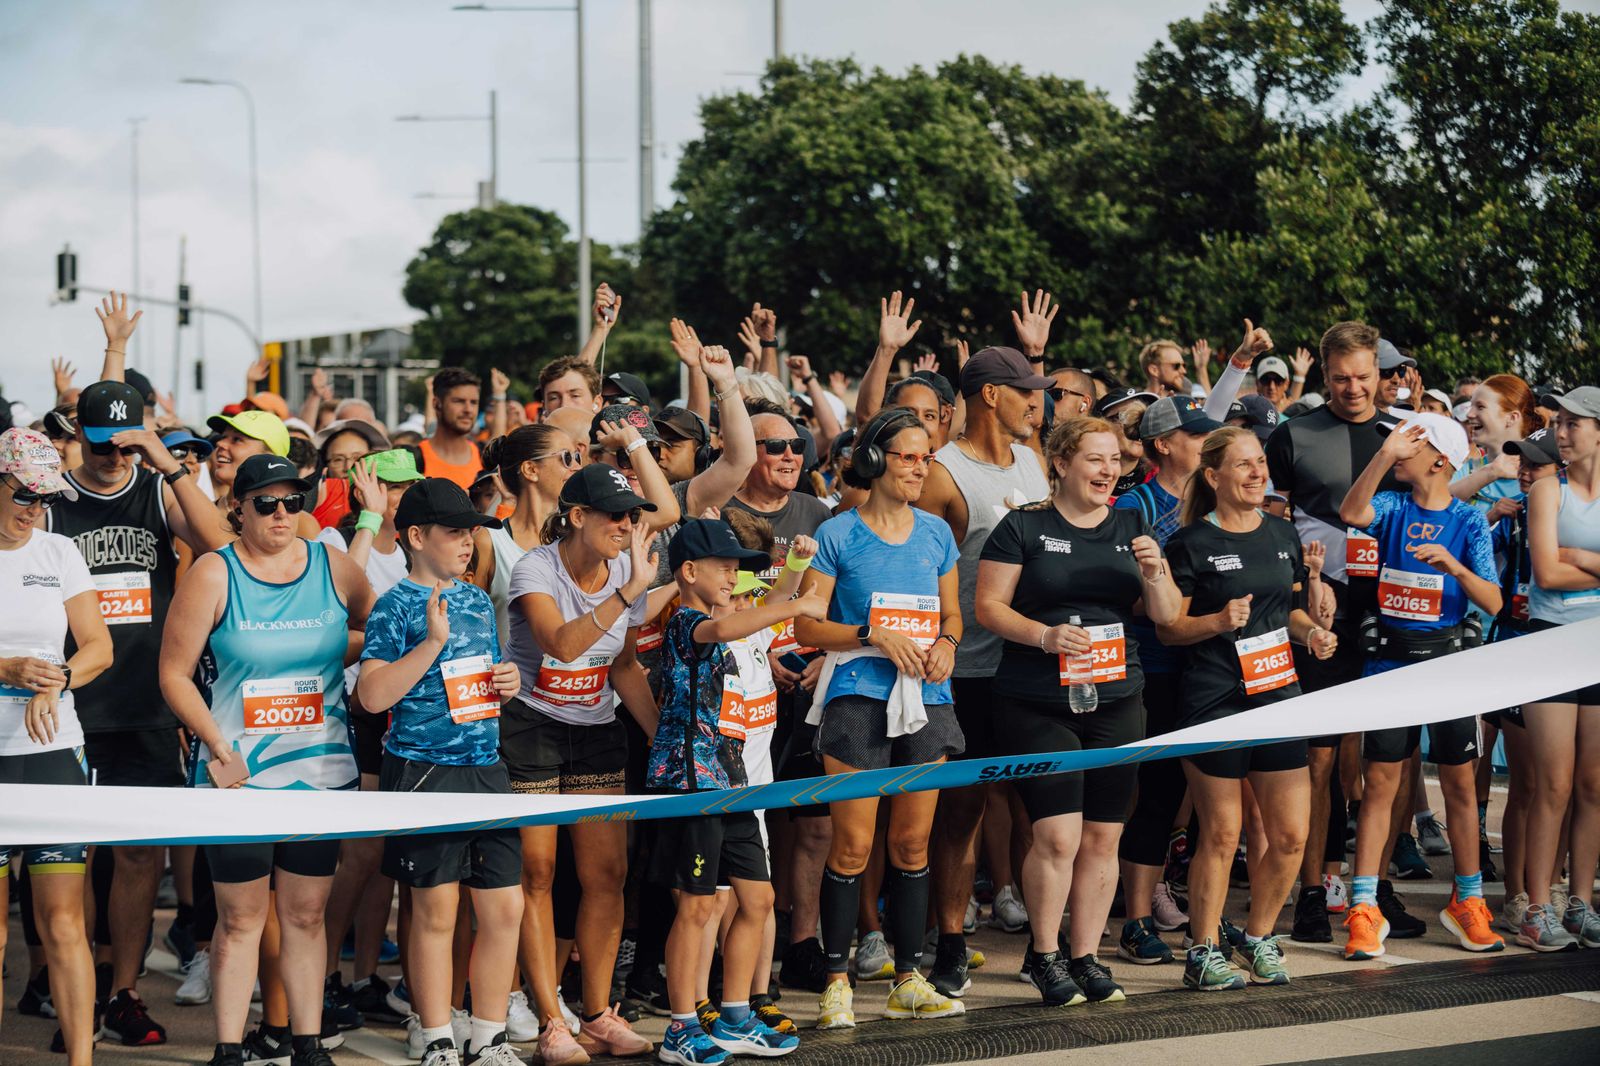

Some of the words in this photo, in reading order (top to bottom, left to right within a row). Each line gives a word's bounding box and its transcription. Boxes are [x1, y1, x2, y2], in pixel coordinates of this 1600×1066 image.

[109, 399, 127, 421] NY
[1406, 522, 1445, 541] CR7
[100, 598, 144, 615] 0244
[1383, 593, 1430, 612] 20165
[239, 618, 323, 631] BLACKMORES
[879, 615, 932, 633] 22564
[1091, 646, 1118, 664] 534
[297, 685, 318, 693] BAYS
[548, 673, 599, 690] 24521
[271, 697, 299, 705] LOZZY
[253, 705, 316, 725] 20079
[977, 761, 1055, 780] BAYS
